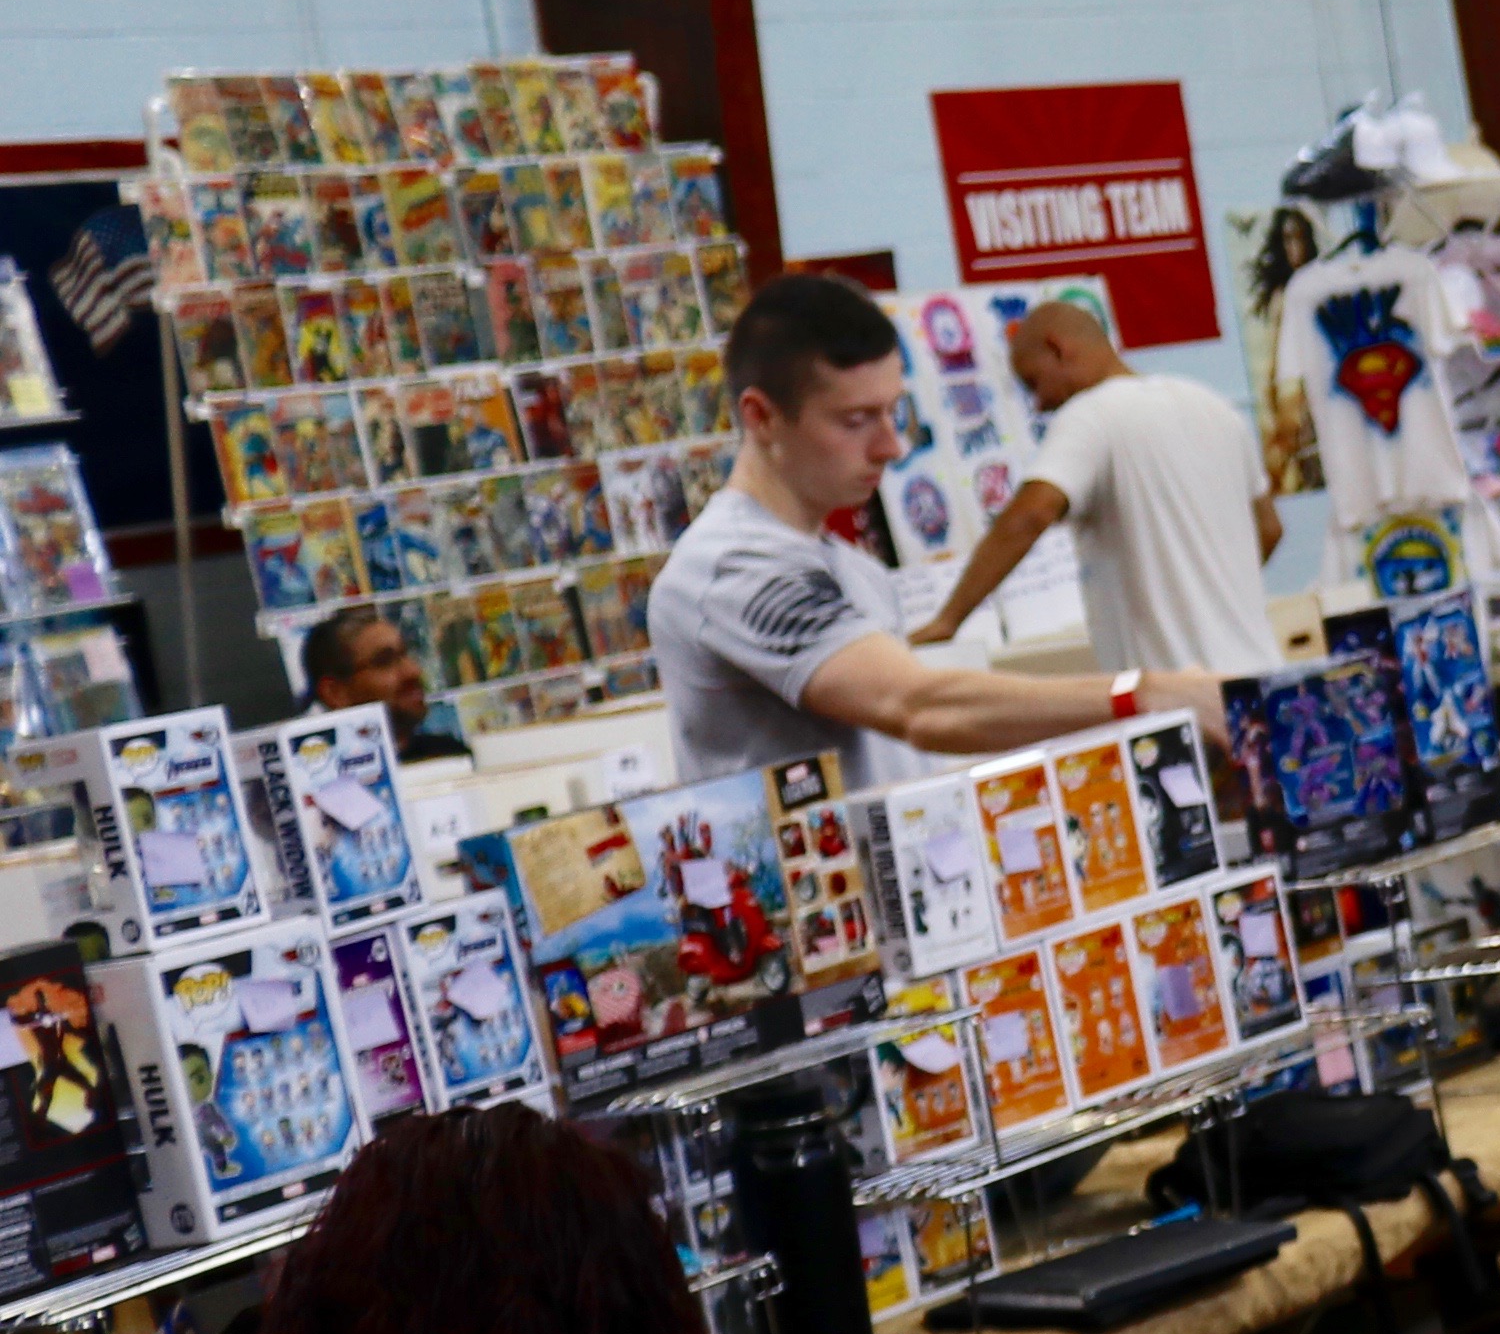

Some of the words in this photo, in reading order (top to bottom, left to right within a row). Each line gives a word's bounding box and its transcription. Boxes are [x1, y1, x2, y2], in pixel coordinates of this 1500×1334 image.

[964, 182, 1108, 252] VISITING
[1104, 176, 1192, 240] TEAM
[258, 741, 293, 814] BLACK
[94, 805, 128, 880] HULK
[138, 1064, 176, 1147] HULK
